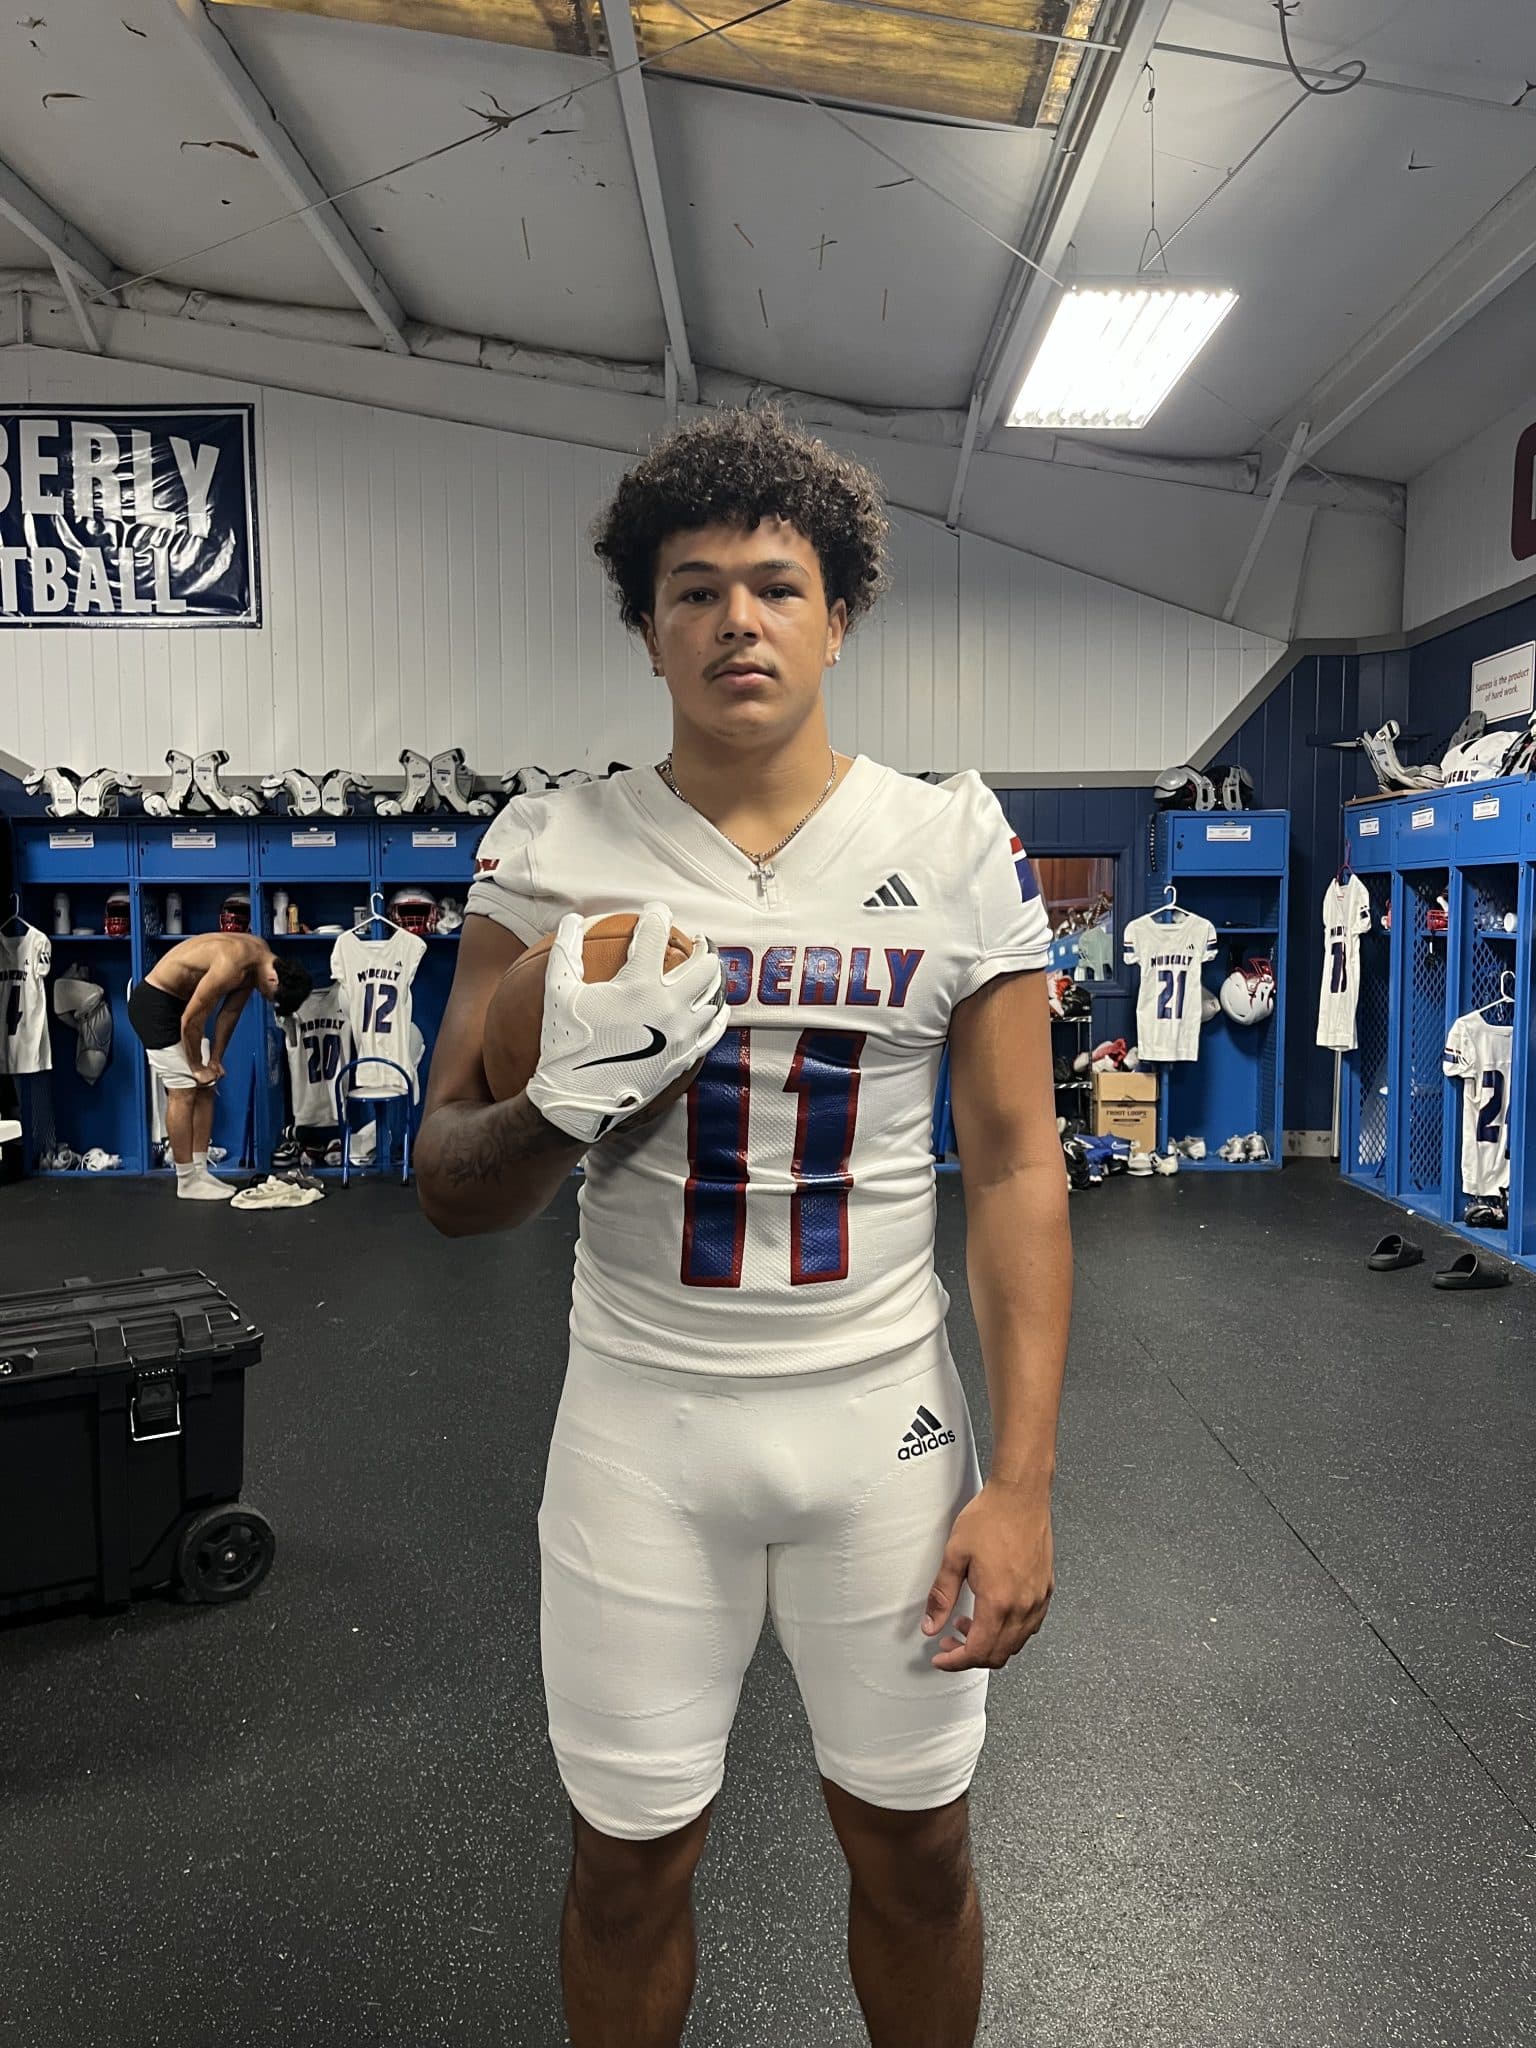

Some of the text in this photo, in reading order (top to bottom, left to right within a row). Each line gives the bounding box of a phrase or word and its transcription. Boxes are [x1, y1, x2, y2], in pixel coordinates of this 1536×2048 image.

[1499, 675, 1508, 685] the
[1508, 668, 1530, 685] product
[362, 983, 398, 1034] 12
[1156, 969, 1188, 1019] 21
[302, 1034, 342, 1085] 20
[680, 1025, 868, 1289] 11
[897, 1430, 956, 1461] adidas
